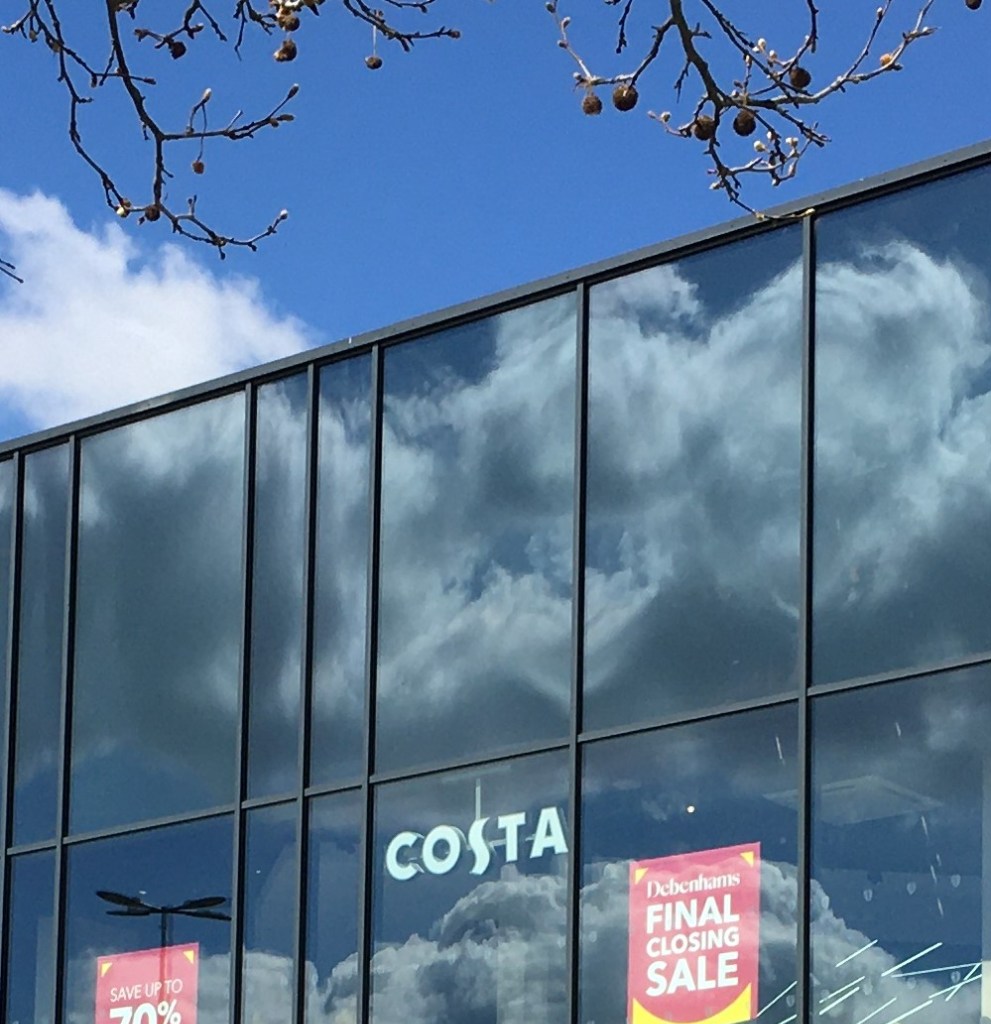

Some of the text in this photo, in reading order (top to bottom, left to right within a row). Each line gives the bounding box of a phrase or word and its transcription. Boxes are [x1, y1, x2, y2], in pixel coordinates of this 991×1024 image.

[385, 805, 569, 881] COSTA
[646, 871, 741, 899] Debenhams
[645, 893, 740, 934] FINAL
[645, 925, 740, 958] CLOSING
[109, 978, 183, 1003] SAVE UP TO
[645, 951, 739, 997] SALE
